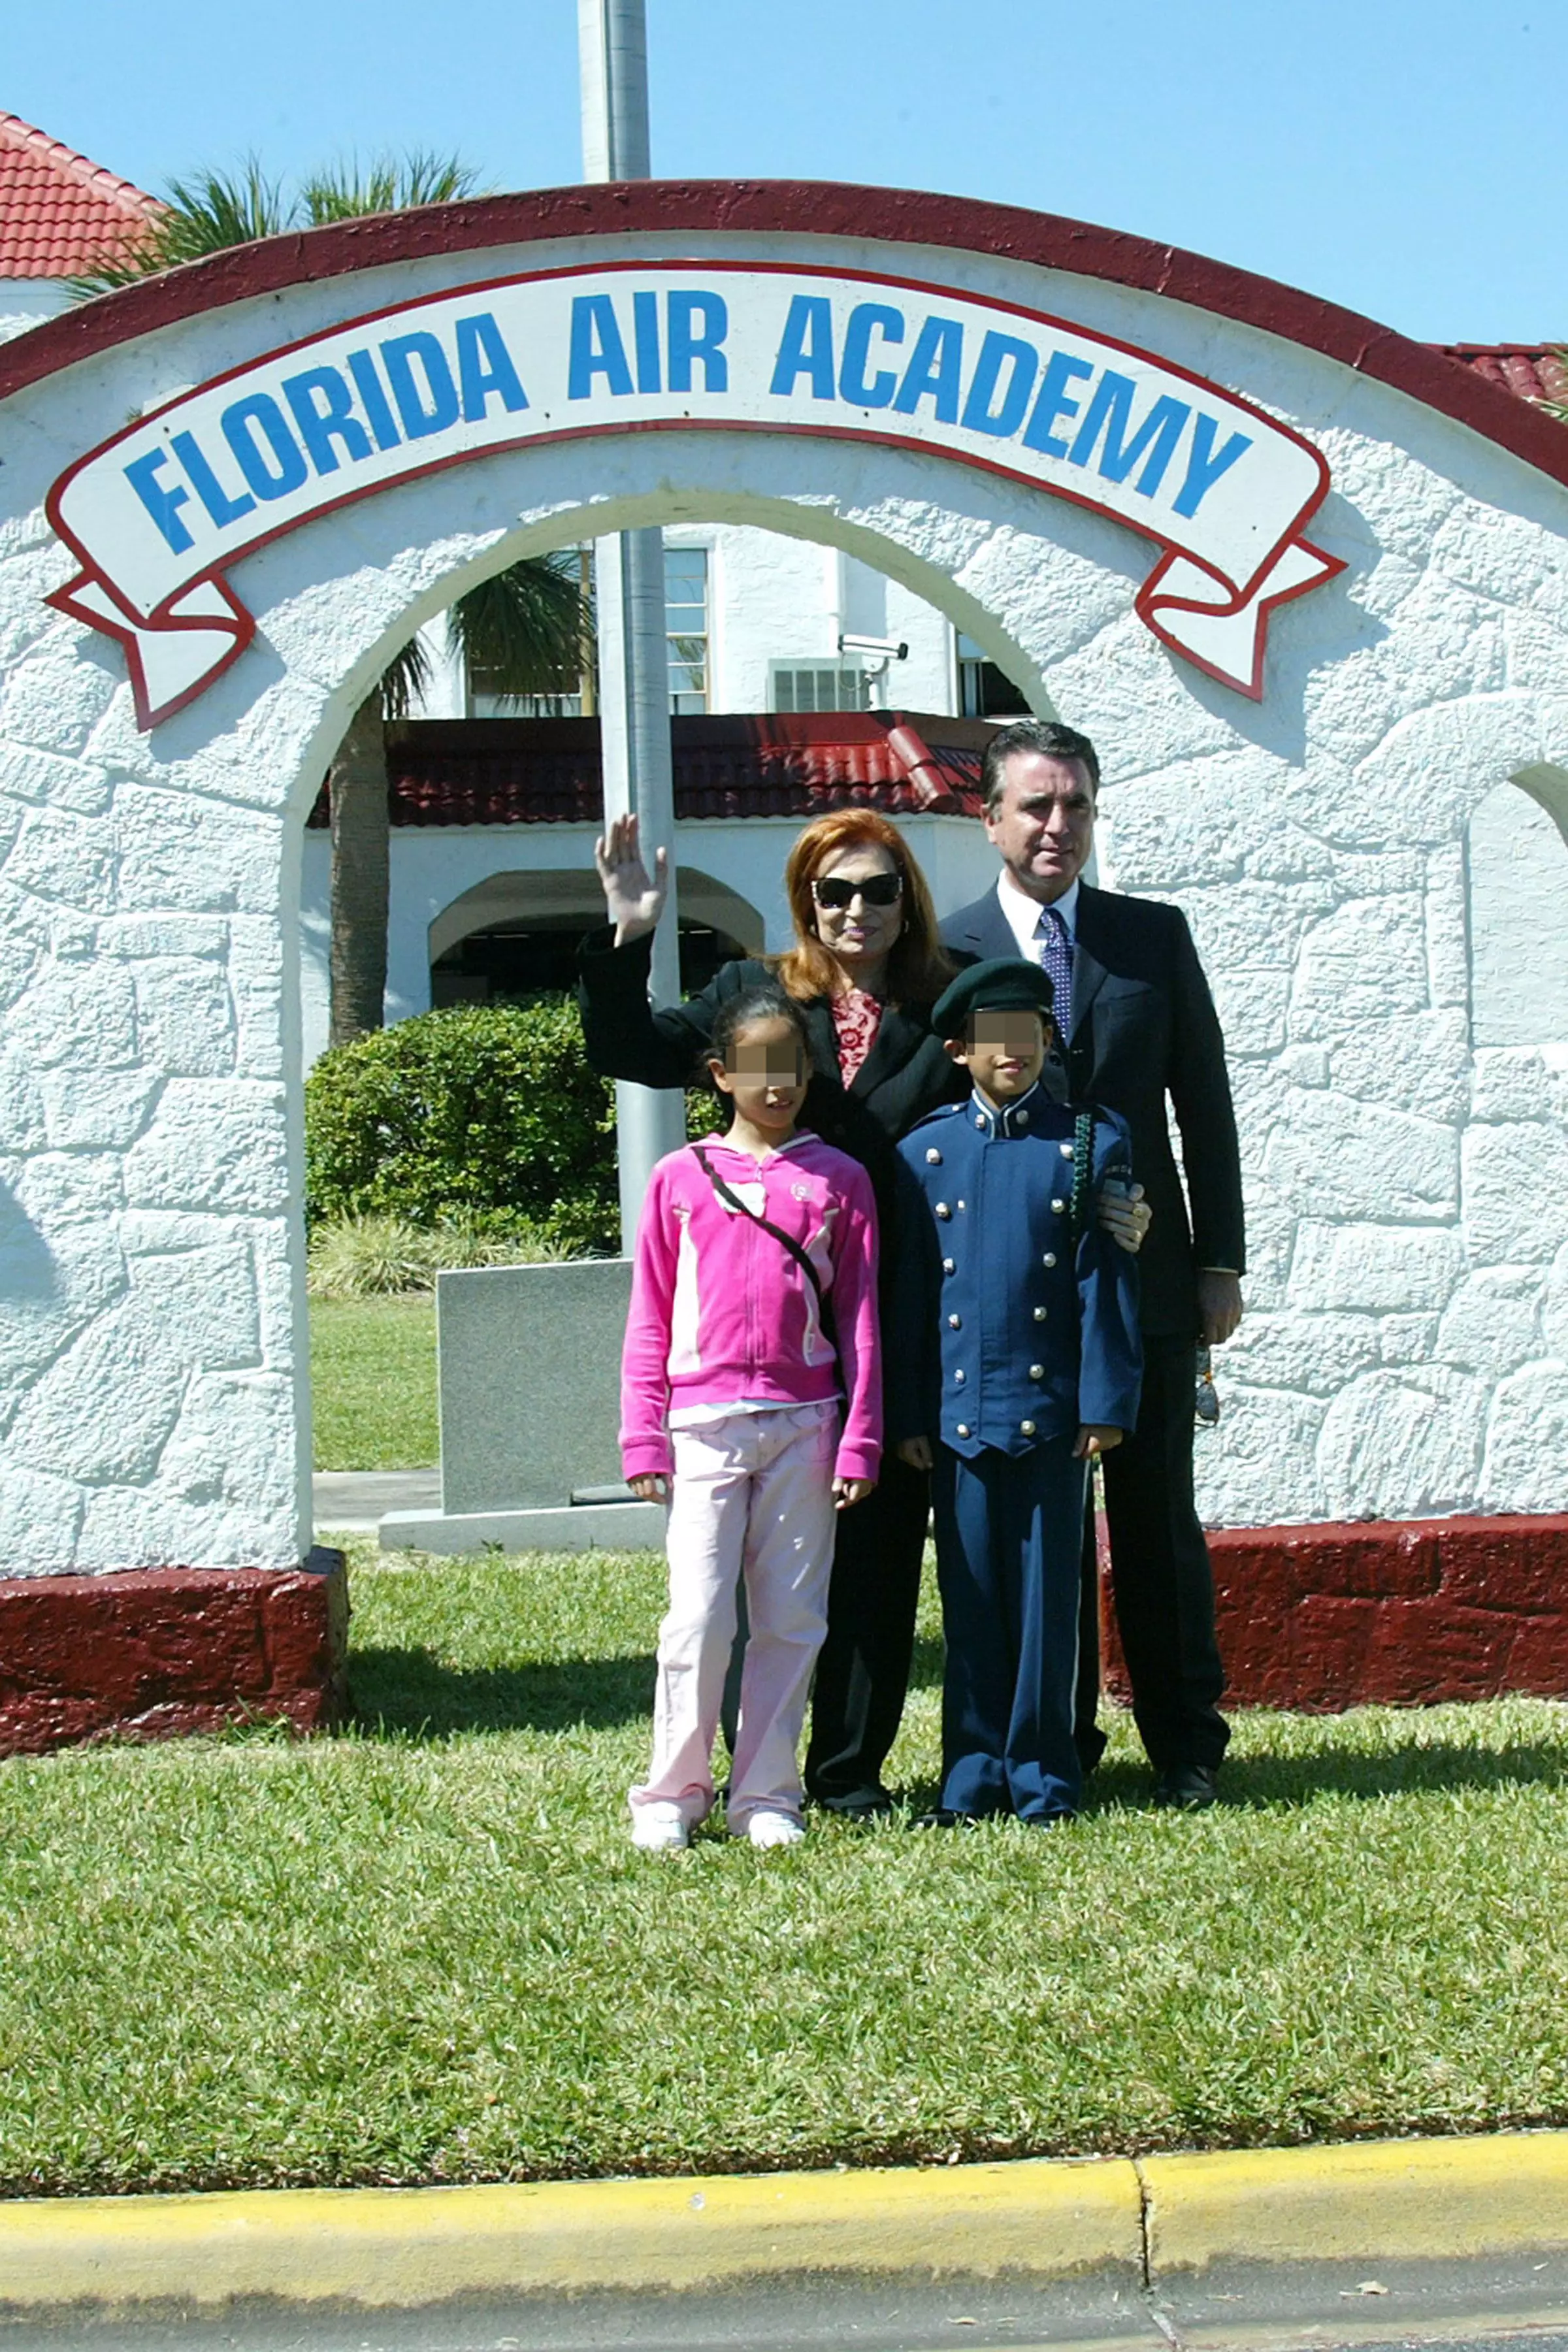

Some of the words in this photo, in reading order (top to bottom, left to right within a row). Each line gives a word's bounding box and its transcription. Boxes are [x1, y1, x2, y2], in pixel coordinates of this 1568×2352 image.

[124, 313, 529, 555] FLORIDA
[568, 289, 728, 400] AIR
[771, 294, 1253, 519] ACADEMY
